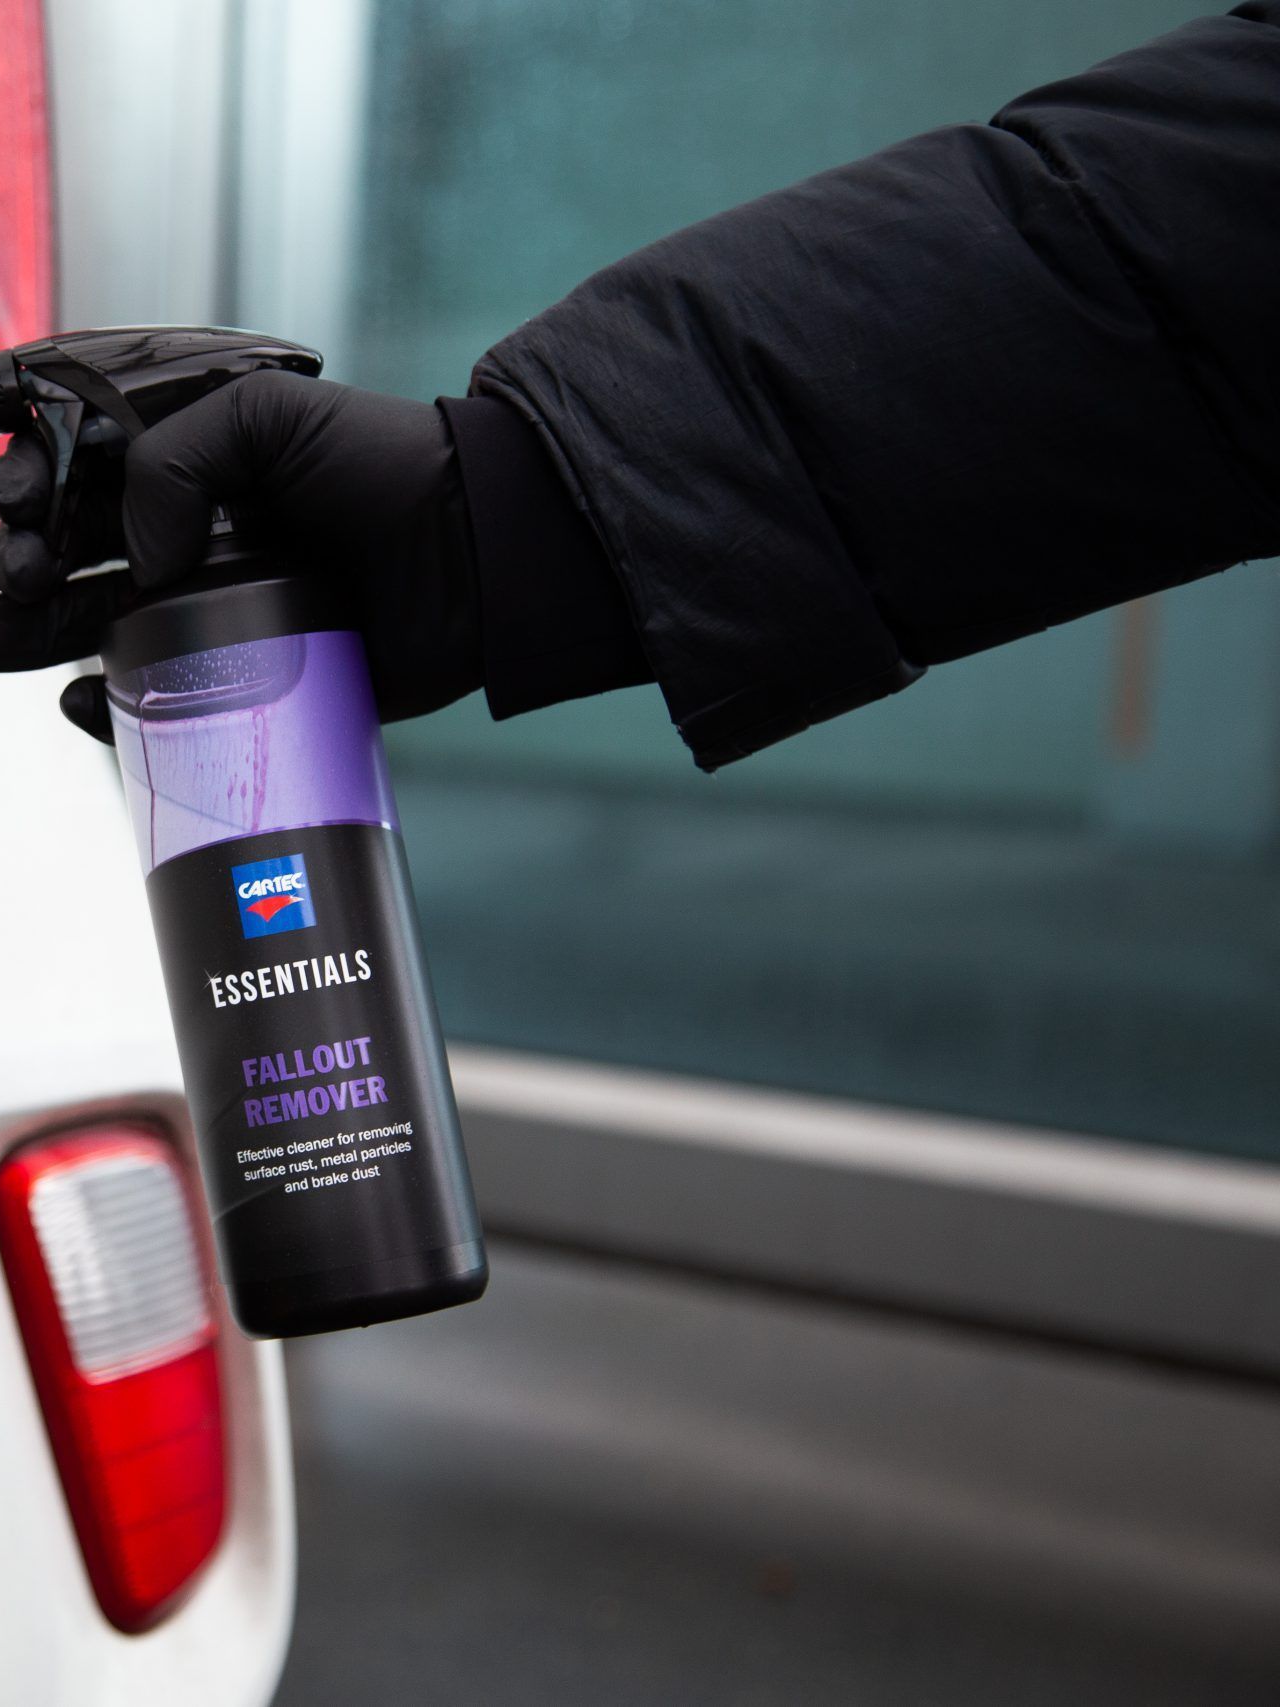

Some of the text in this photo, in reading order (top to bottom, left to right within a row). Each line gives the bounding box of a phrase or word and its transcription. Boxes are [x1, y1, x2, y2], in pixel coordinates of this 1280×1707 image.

[238, 872, 305, 899] CARTEC
[210, 949, 372, 1008] ESSENTIALS
[242, 1036, 372, 1087] FALLOUT
[244, 1075, 390, 1128] REMOVER
[237, 1121, 413, 1163] Effective cleaner for removing
[244, 1141, 412, 1181] surface rust, metal particles
[284, 1164, 381, 1193] and brake dust
